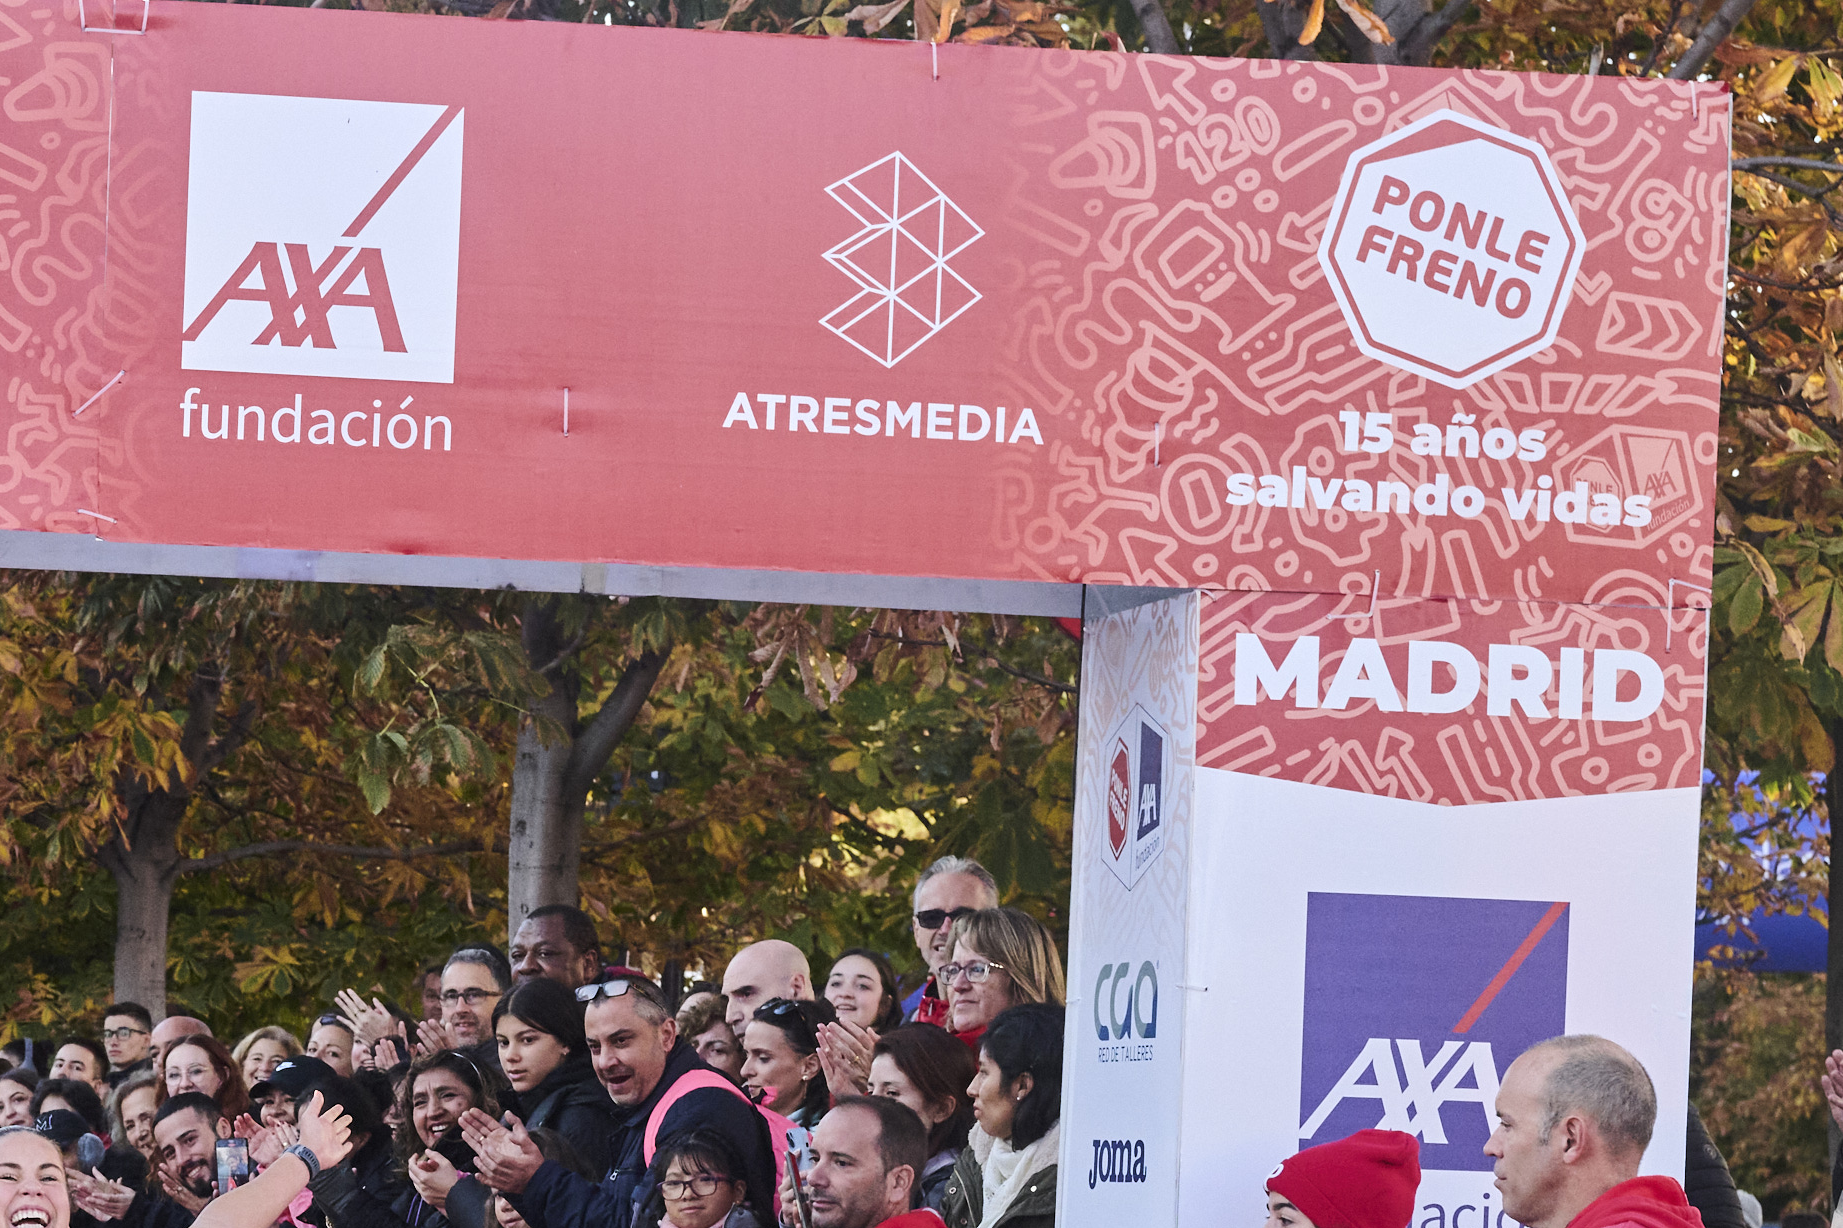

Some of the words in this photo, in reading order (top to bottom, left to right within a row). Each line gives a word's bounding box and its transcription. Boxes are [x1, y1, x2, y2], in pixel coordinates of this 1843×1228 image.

[1370, 174, 1552, 275] PONLE
[181, 241, 409, 354] AXA
[1354, 224, 1533, 320] FRENO
[179, 386, 454, 452] fundación
[722, 391, 1045, 447] ATRESMEDIA
[1338, 410, 1394, 455] 15
[1410, 410, 1547, 464] años
[1225, 464, 1485, 521] salvando
[1505, 480, 1653, 529] vidas
[1232, 632, 1666, 723] MADRID
[1137, 783, 1157, 831] AXA
[1299, 1037, 1502, 1146] AXA
